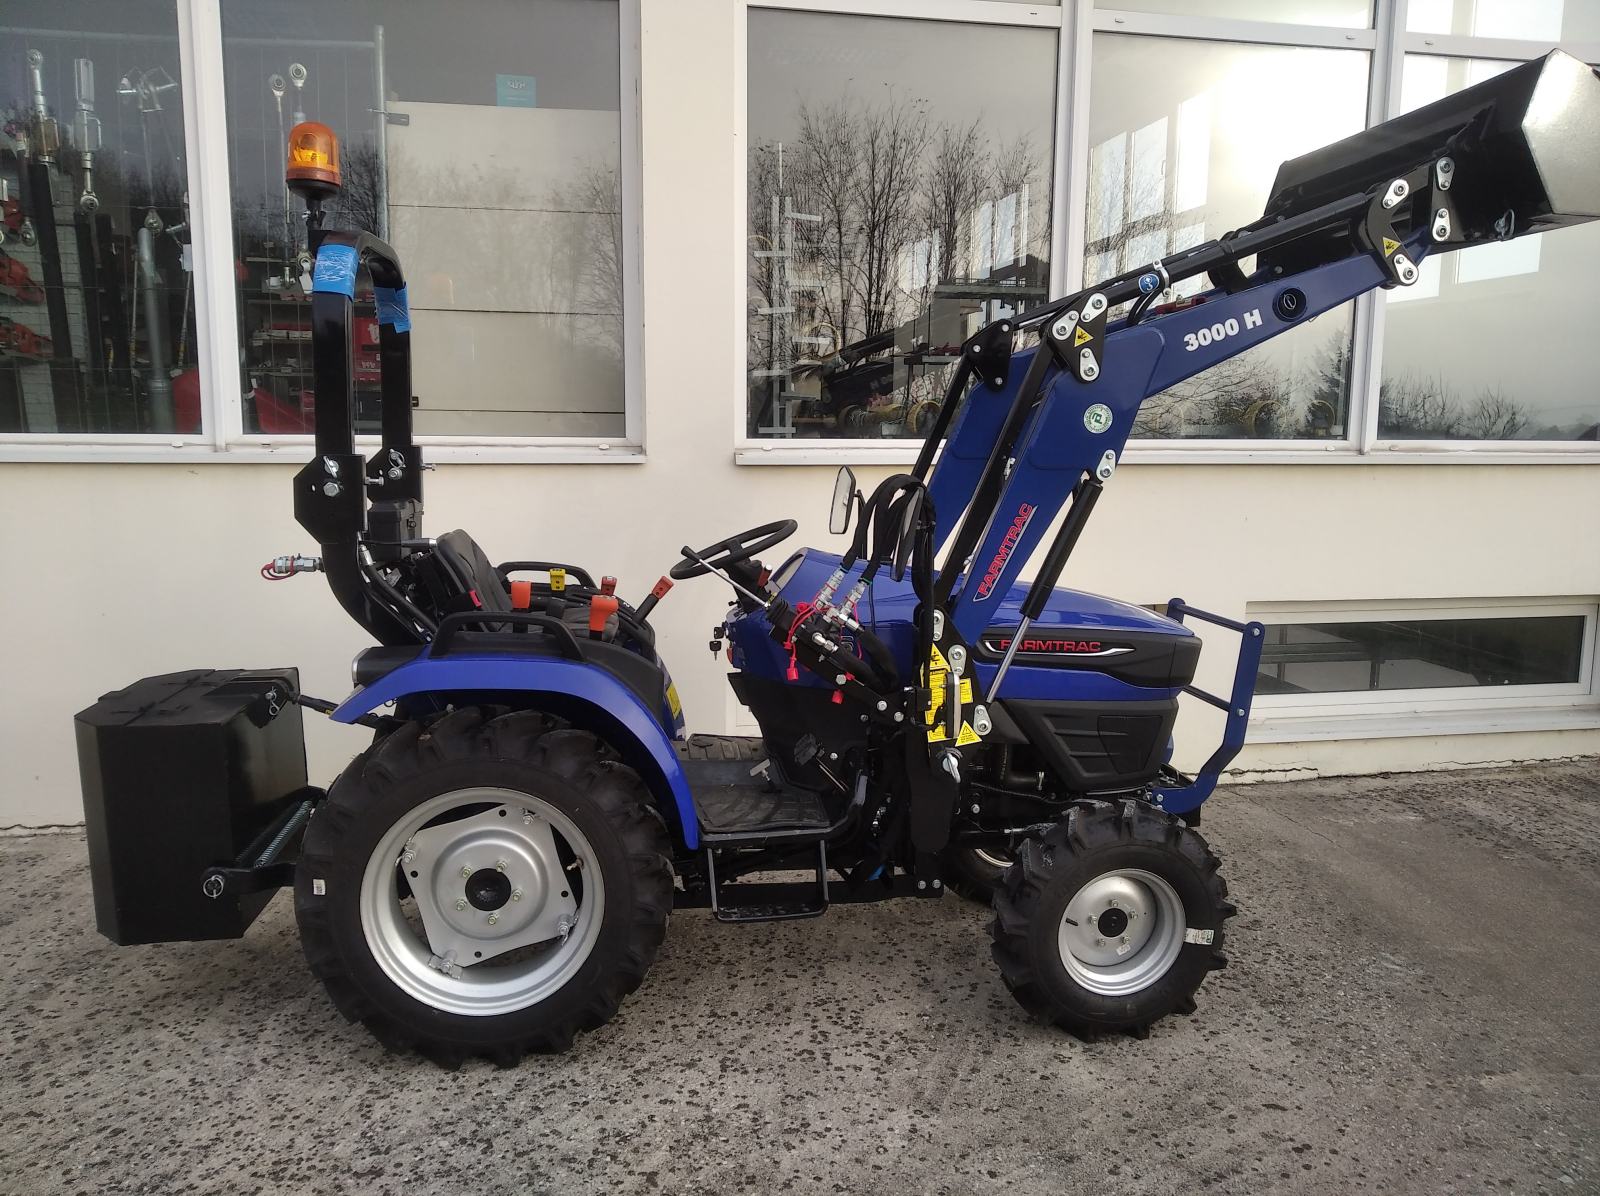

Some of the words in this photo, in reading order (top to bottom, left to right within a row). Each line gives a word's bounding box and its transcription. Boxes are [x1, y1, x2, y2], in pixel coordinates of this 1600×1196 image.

[1183, 318, 1240, 352] 3000
[1243, 308, 1263, 330] H
[978, 503, 1034, 596] FARMTRAC
